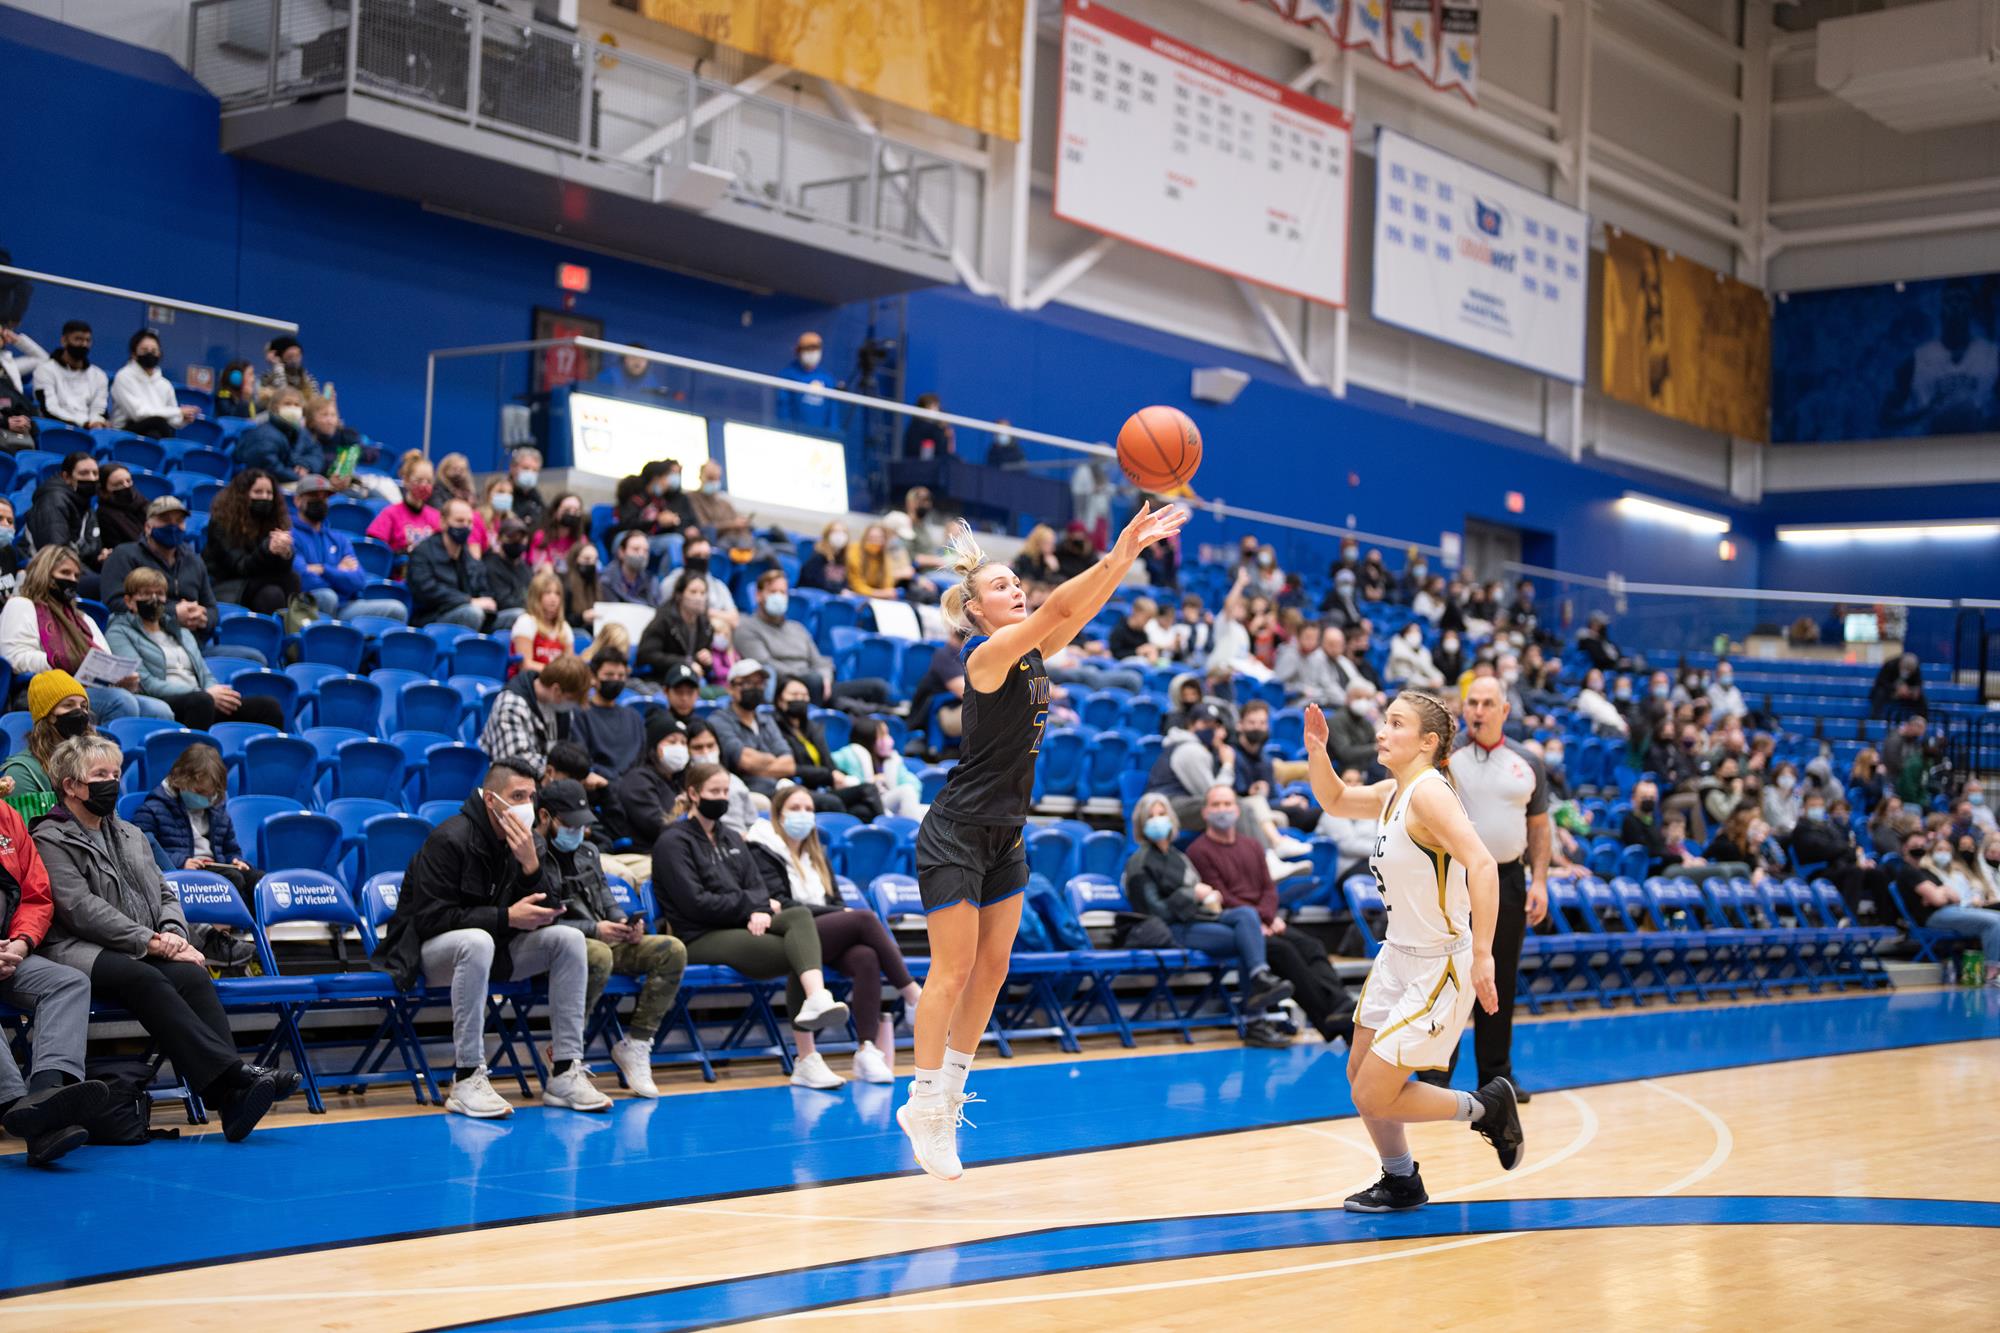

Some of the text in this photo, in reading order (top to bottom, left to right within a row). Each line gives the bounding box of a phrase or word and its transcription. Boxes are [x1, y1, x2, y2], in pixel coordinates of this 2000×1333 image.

[181, 883, 229, 894] University
[292, 884, 335, 895] University
[184, 893, 232, 904] of Victoria
[295, 894, 338, 905] of Victoria
